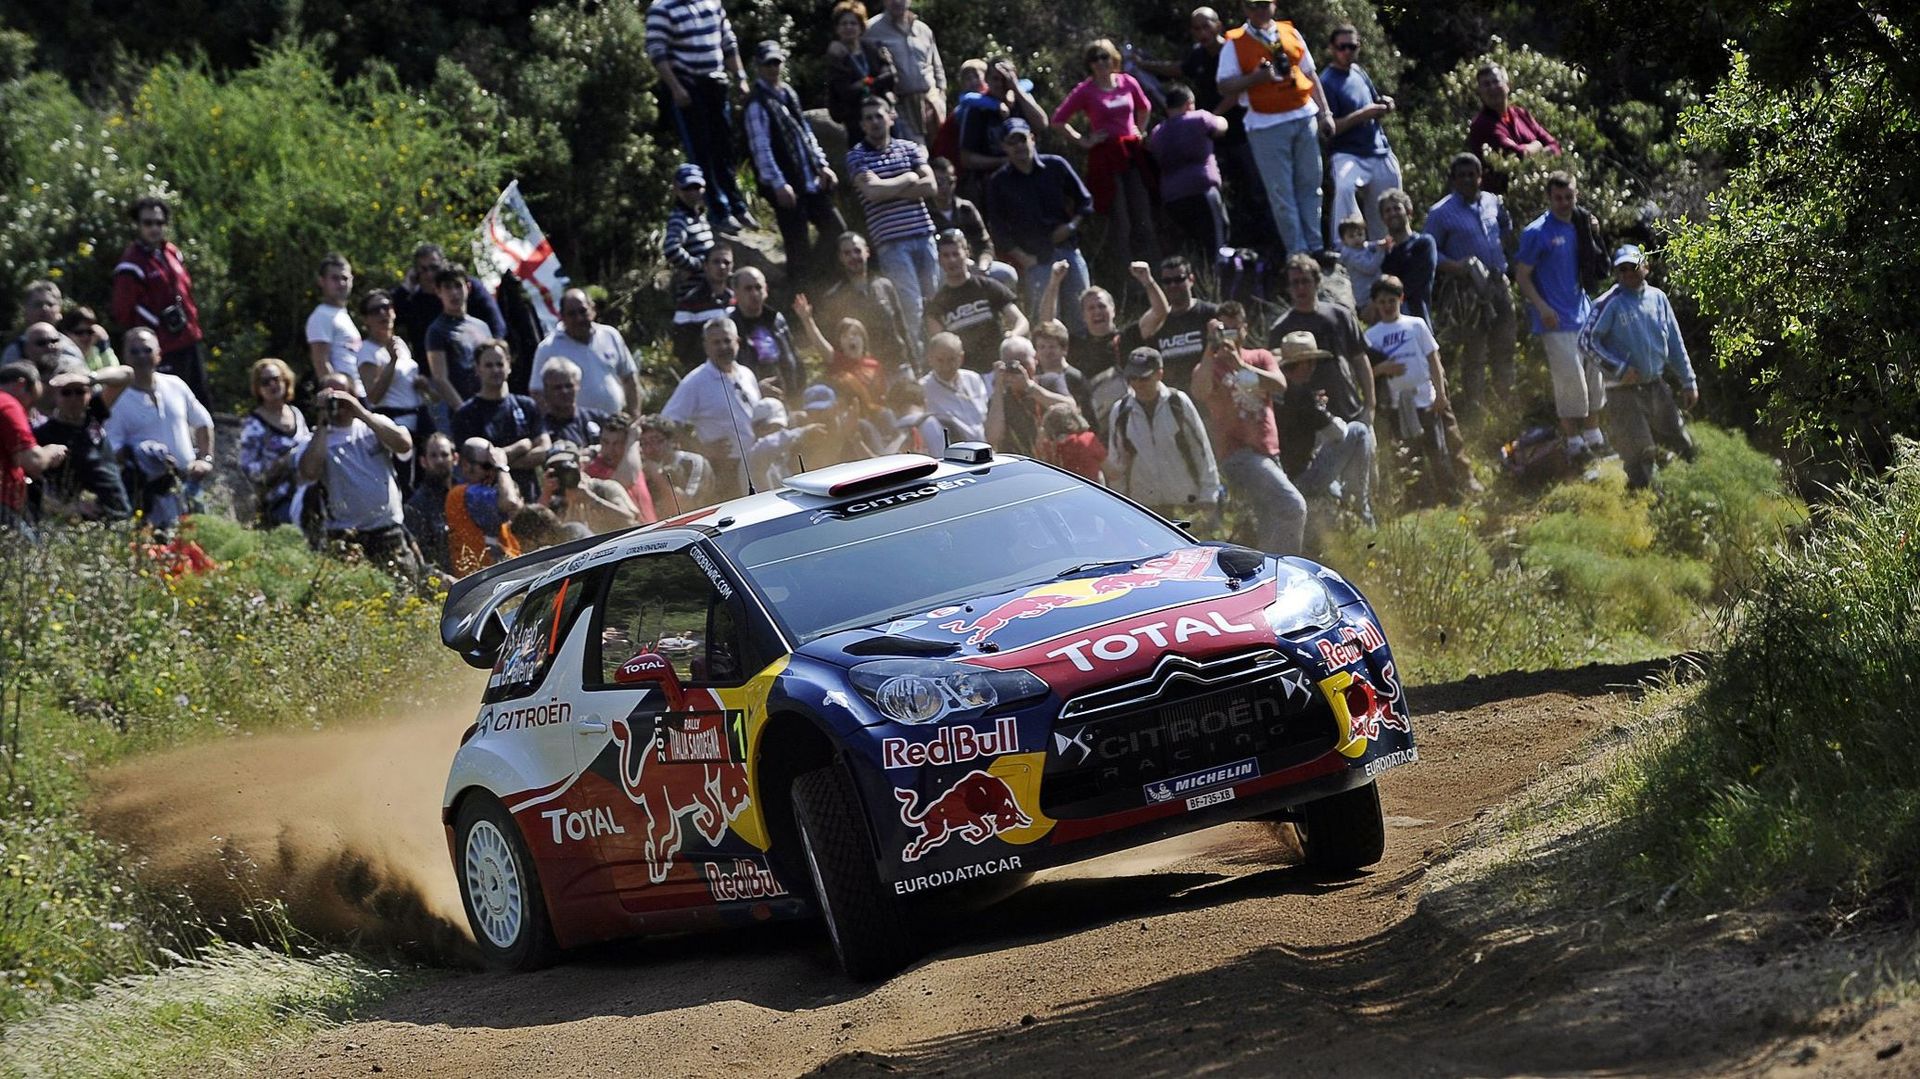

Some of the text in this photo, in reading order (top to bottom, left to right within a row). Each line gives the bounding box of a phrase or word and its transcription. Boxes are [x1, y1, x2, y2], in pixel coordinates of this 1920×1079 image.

[1158, 330, 1203, 350] WRC
[1046, 611, 1256, 672] TOTAL
[624, 660, 665, 674] TOTAL
[655, 716, 666, 762] 2011
[668, 725, 722, 760] ITALIA SARDEGNA
[684, 718, 701, 731] RALLY
[733, 712, 746, 759] 1
[1175, 763, 1252, 792] MICHELIN
[541, 806, 625, 844] TOTAL
[894, 856, 1022, 895] EURODATACAR
